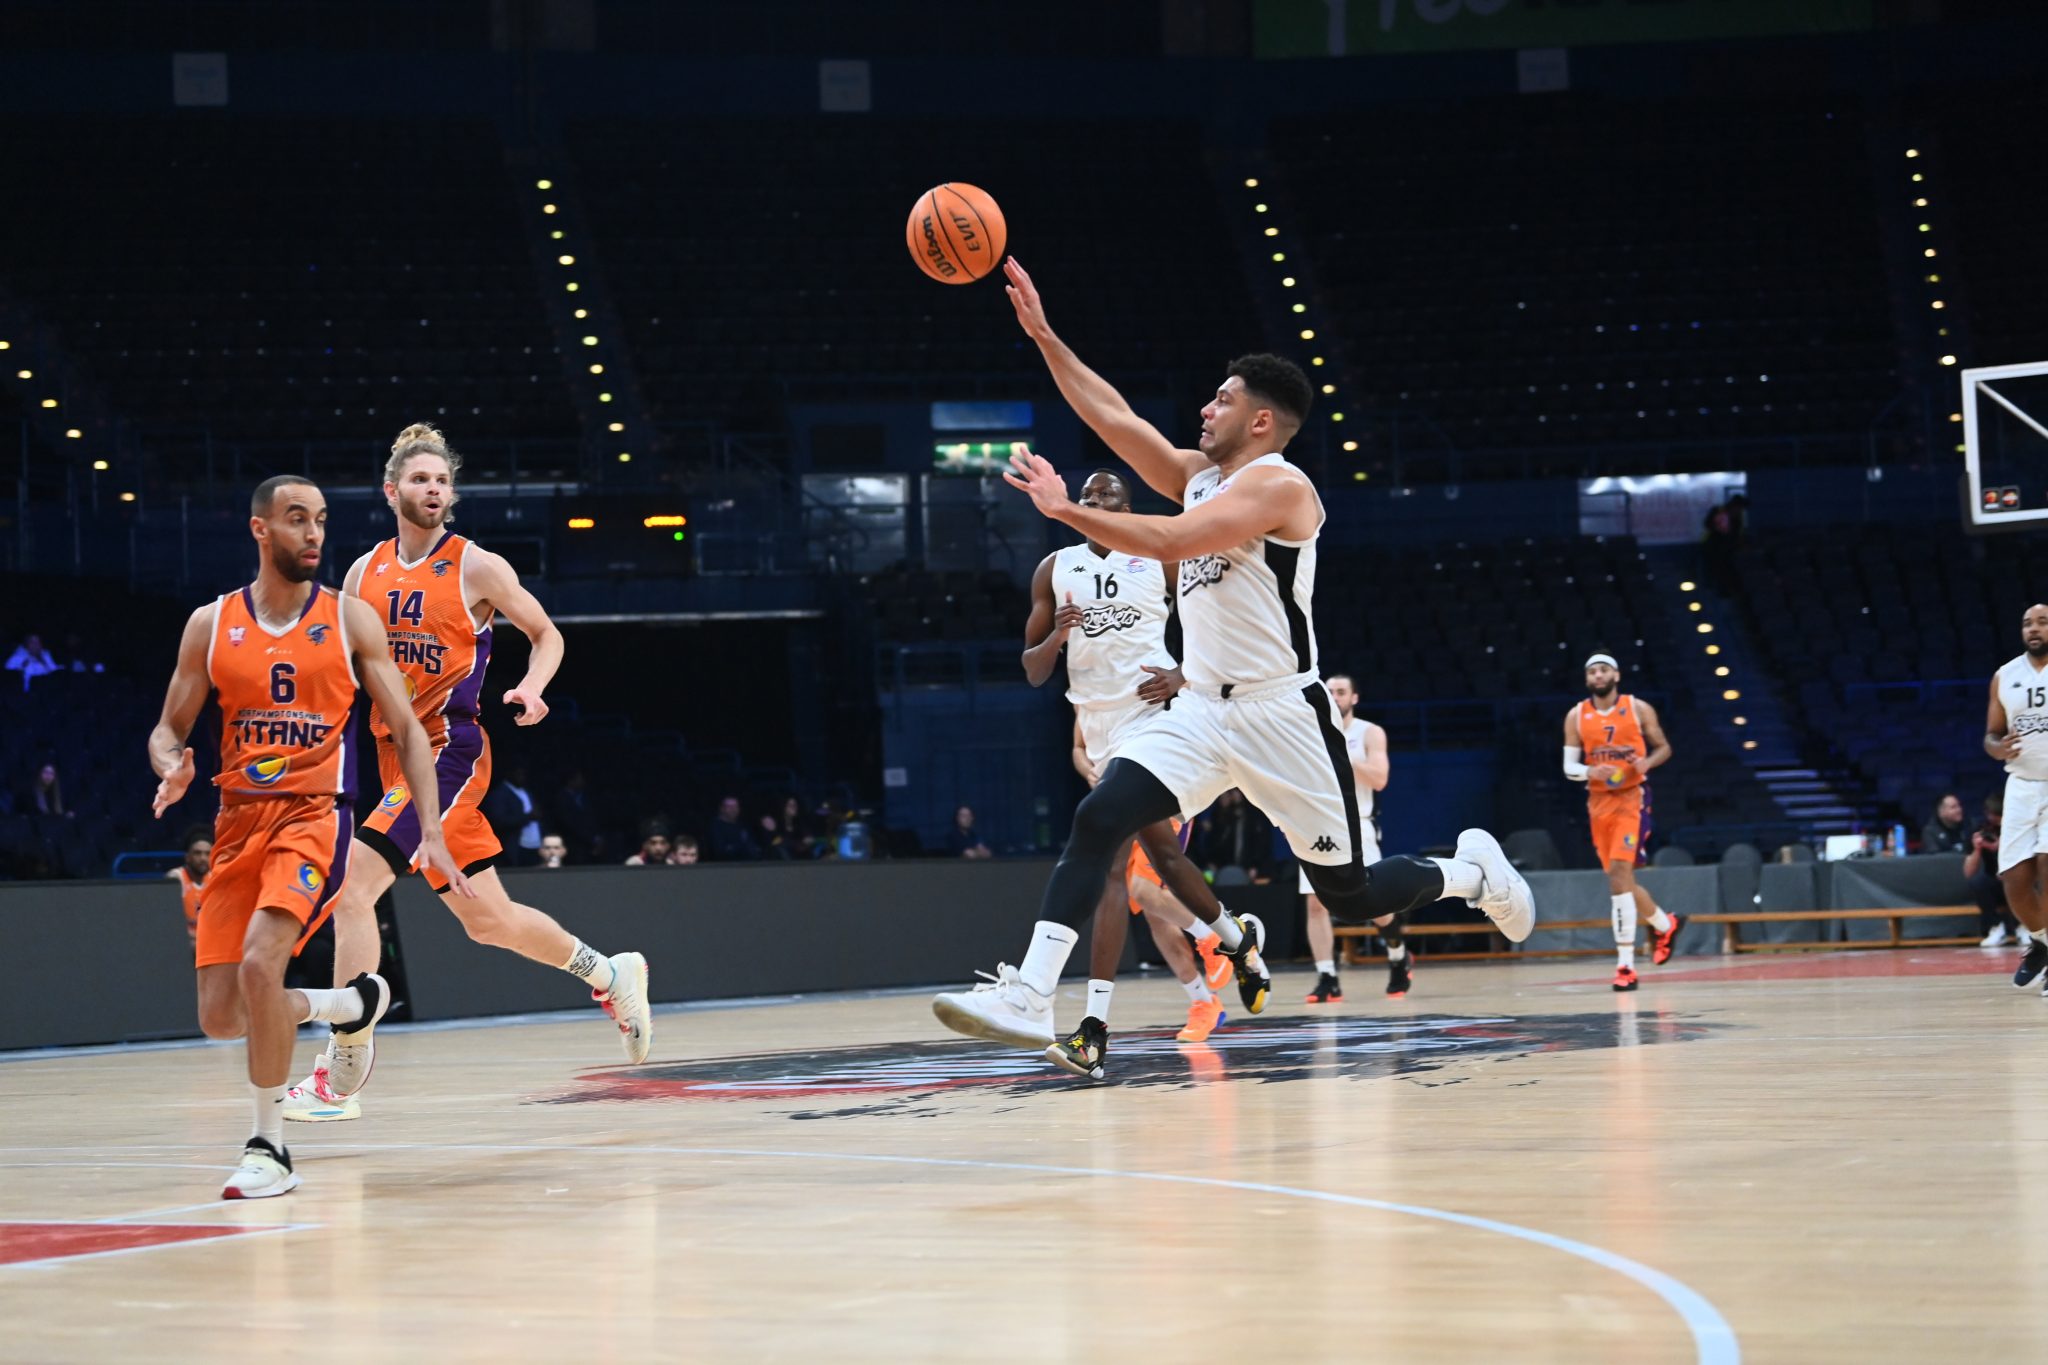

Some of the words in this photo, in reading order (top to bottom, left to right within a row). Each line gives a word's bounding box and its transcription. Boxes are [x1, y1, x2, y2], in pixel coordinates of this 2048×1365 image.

[1094, 572, 1118, 599] 16
[387, 590, 425, 627] 14
[270, 662, 296, 704] 6
[2027, 686, 2046, 709] 15
[229, 720, 336, 752] TITANS
[1603, 725, 1615, 743] 7
